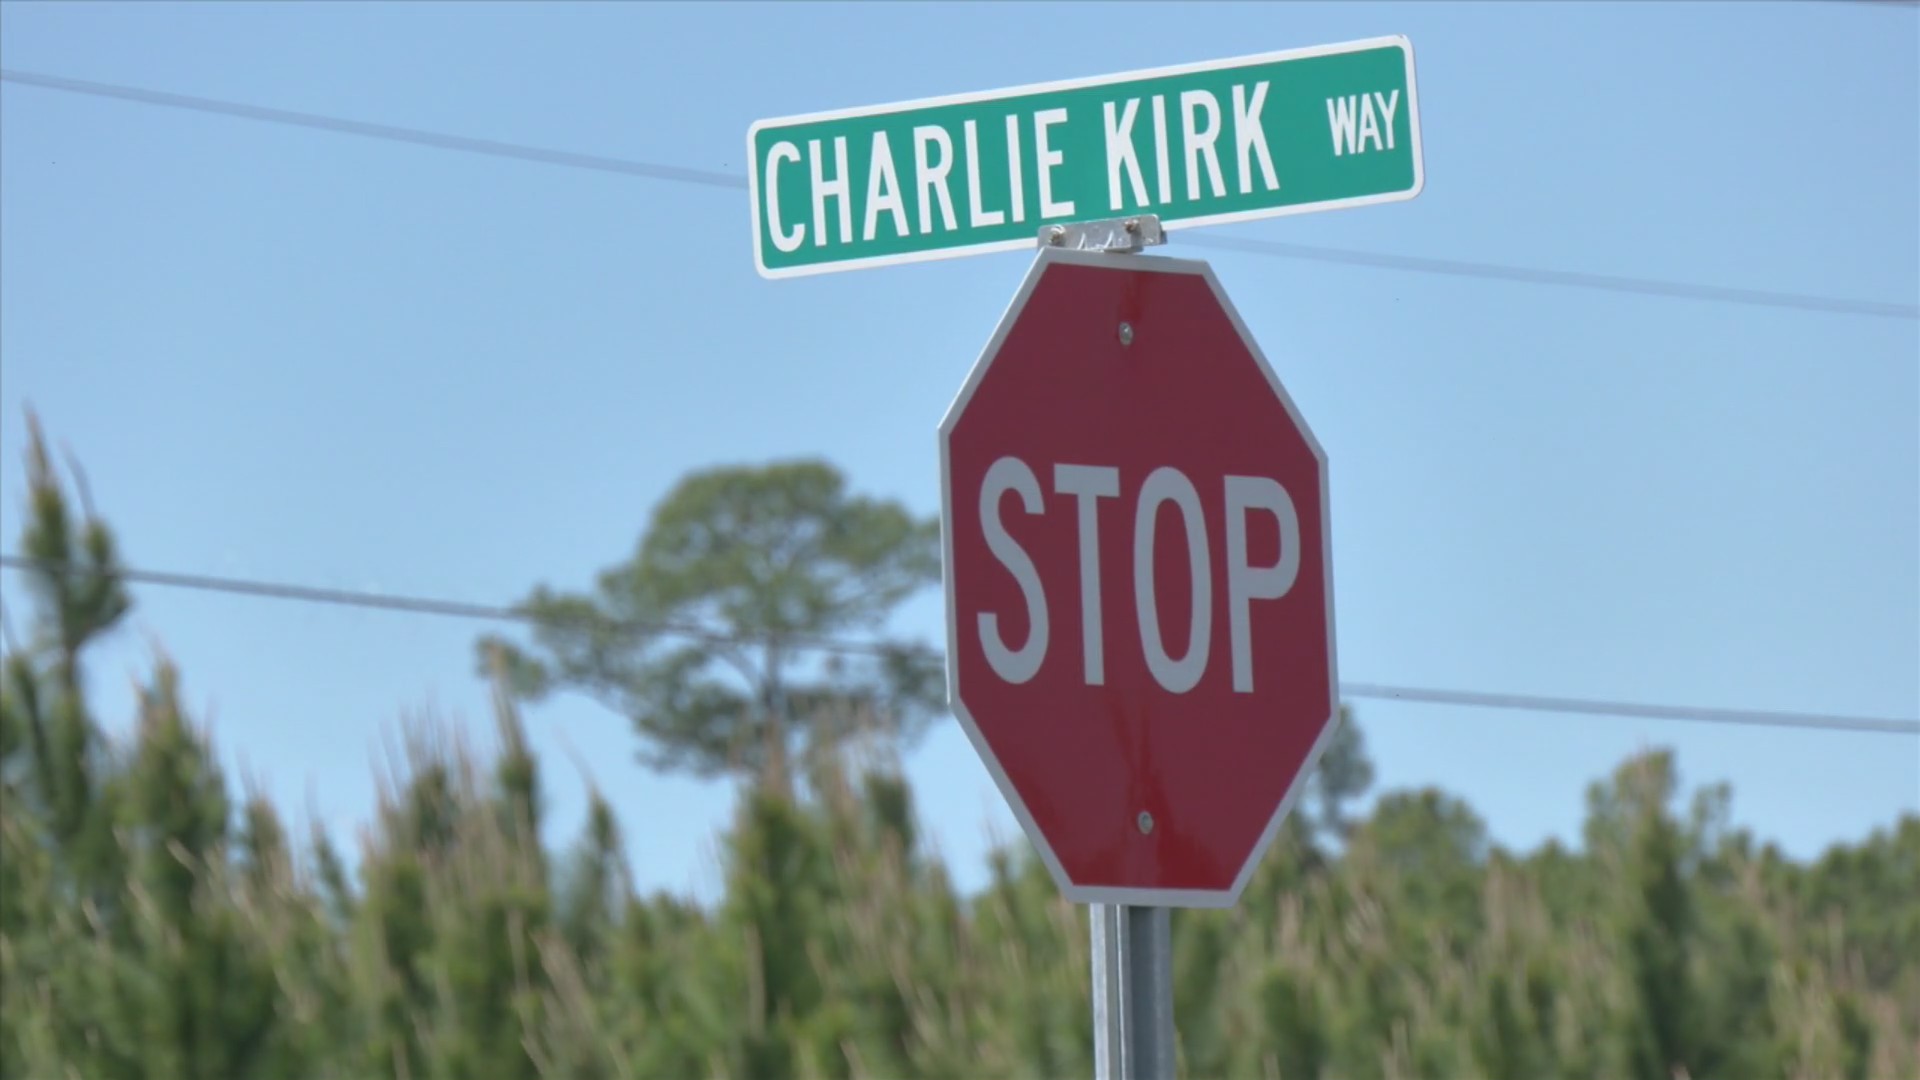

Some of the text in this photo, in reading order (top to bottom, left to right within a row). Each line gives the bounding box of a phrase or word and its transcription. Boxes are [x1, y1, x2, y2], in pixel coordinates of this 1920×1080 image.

[765, 80, 1399, 253] CHARLIE KIRK WAY
[977, 456, 1300, 694] STOP
